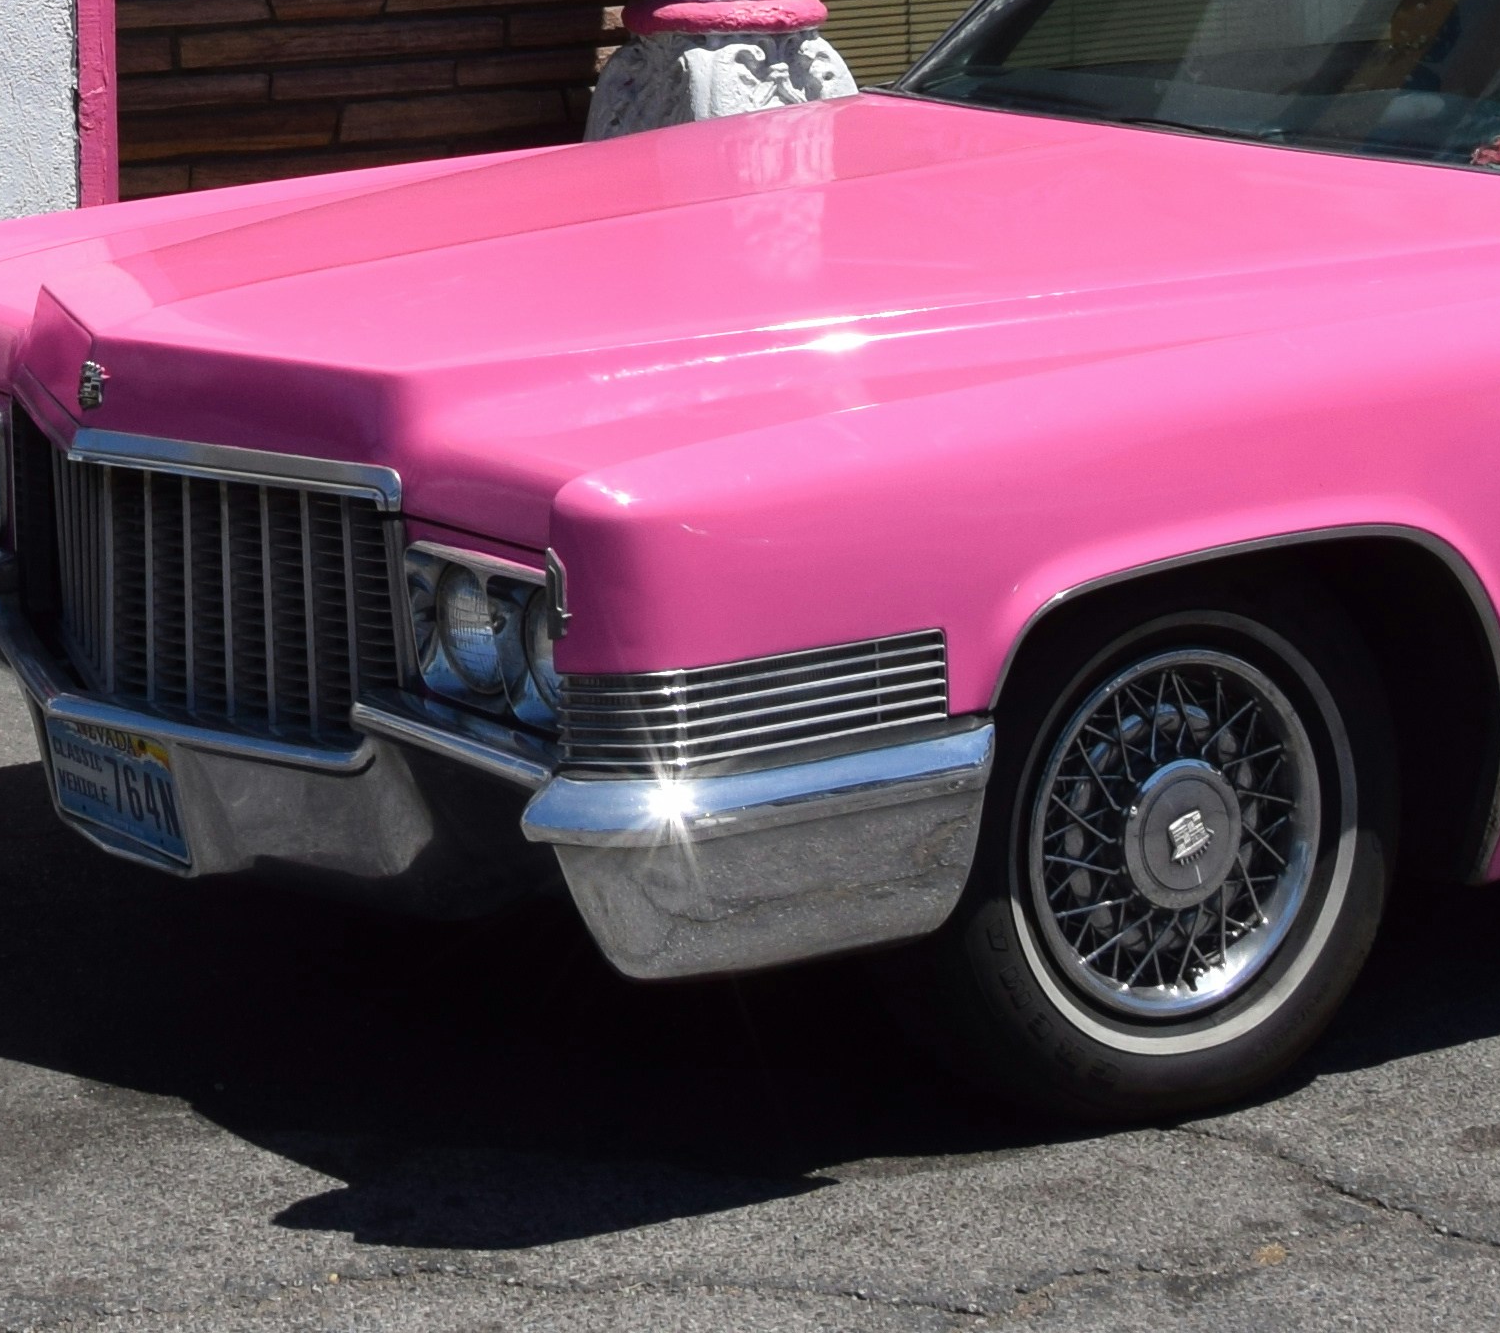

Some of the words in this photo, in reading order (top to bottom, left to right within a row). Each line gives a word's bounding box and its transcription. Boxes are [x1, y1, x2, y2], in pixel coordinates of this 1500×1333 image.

[76, 722, 137, 757] NEVADA
[52, 735, 103, 773] CLASSIC
[103, 755, 182, 839] 764N
[57, 767, 110, 806] VEHICLE
